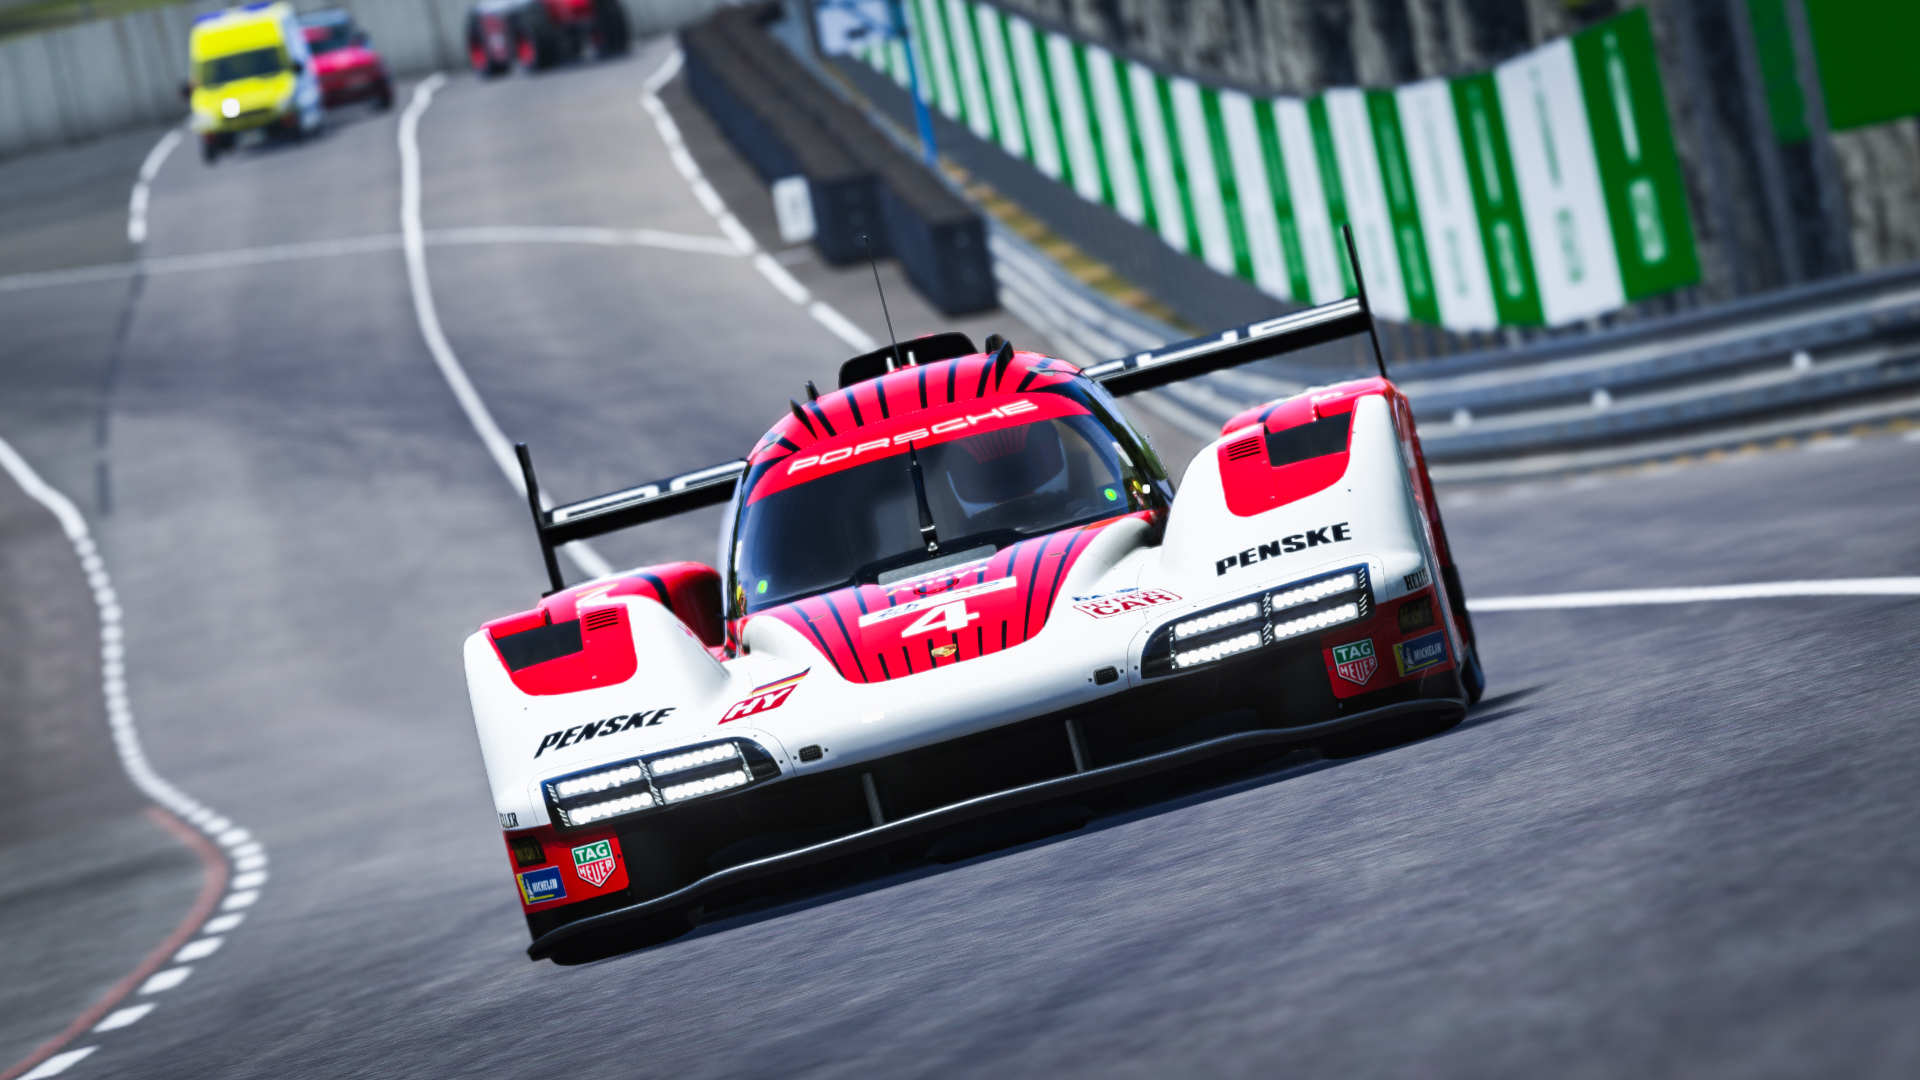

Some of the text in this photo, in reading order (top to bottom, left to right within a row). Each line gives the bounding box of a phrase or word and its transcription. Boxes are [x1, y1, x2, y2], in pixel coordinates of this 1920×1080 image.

[787, 400, 1038, 475] PORSCHE
[1214, 521, 1352, 577] PENSKE
[1093, 594, 1172, 615] CAR
[901, 600, 980, 638] 4
[1337, 643, 1371, 661] TAG
[1413, 642, 1442, 662] MICHELIN
[1340, 658, 1375, 681] HEUER
[724, 687, 793, 720] HY
[533, 707, 678, 760] PENSKE
[575, 844, 609, 862] TAG
[578, 860, 613, 884] HEUER
[531, 877, 558, 893] MICHELIN
